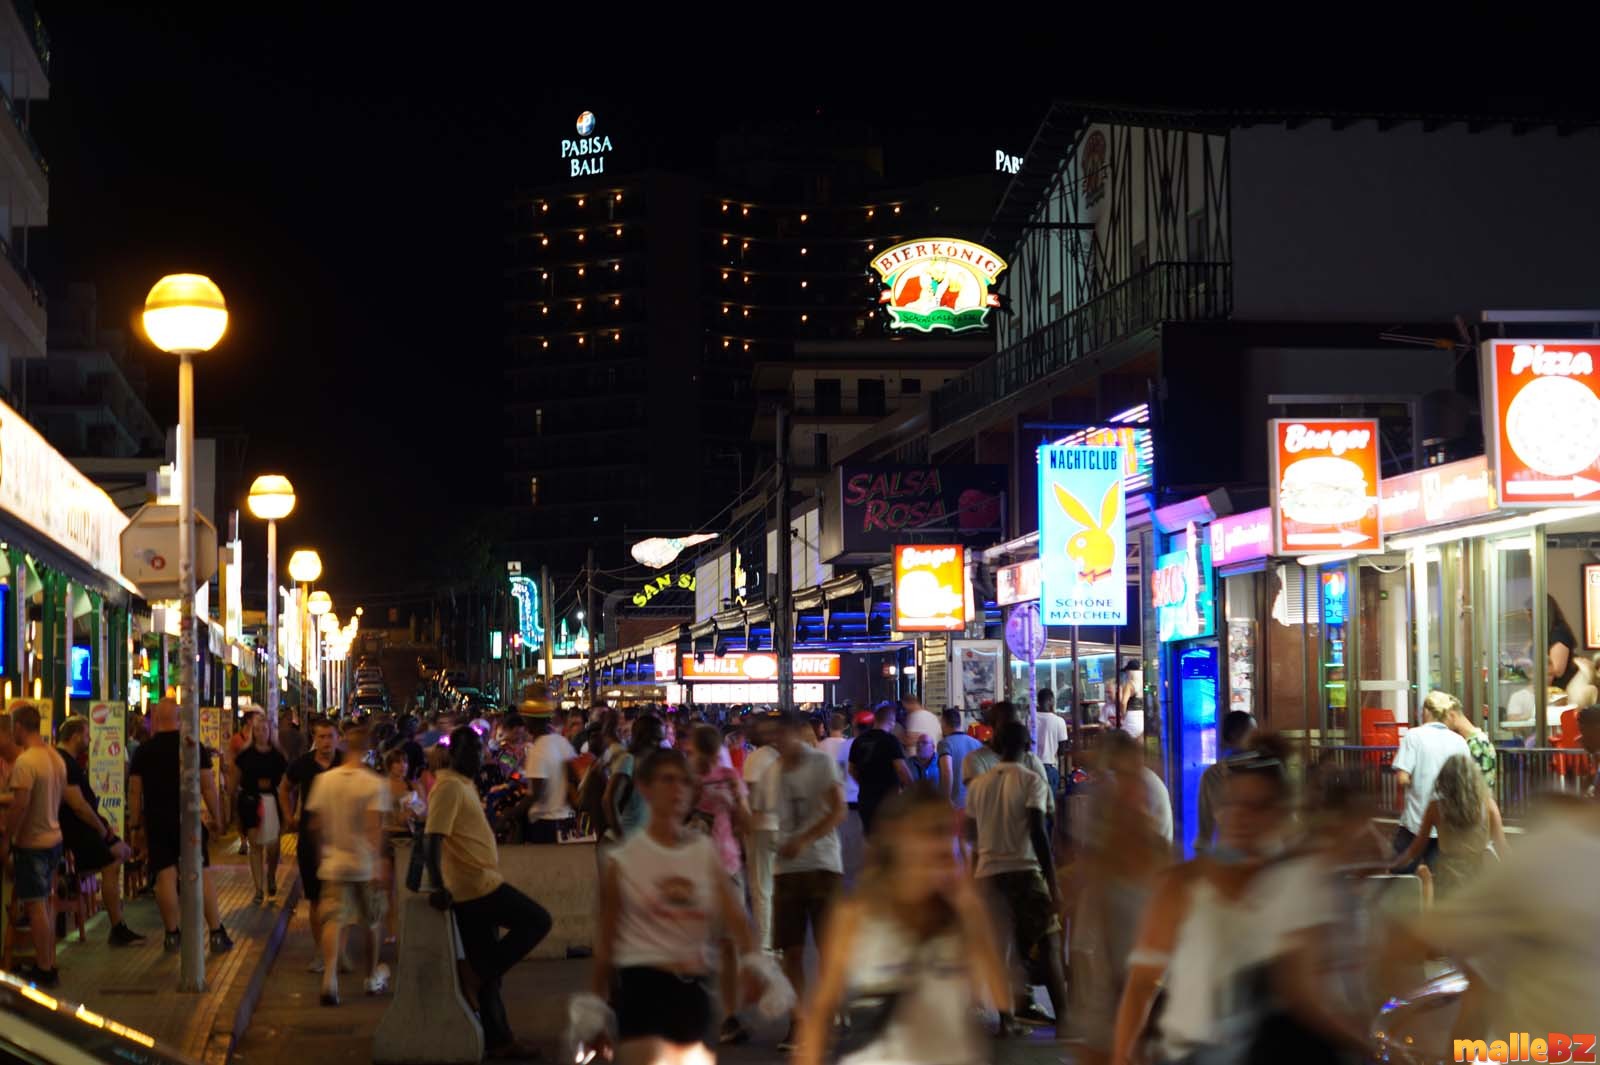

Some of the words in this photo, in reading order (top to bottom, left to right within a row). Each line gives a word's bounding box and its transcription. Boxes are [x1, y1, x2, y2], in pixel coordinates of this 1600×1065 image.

[561, 136, 613, 158] PABISA
[570, 156, 604, 178] BALI
[1284, 423, 1370, 456] Burger
[1050, 449, 1118, 471] NACHTCLUB
[845, 466, 942, 506] SALSA
[863, 497, 946, 533] ROSA
[632, 573, 672, 608] SAN
